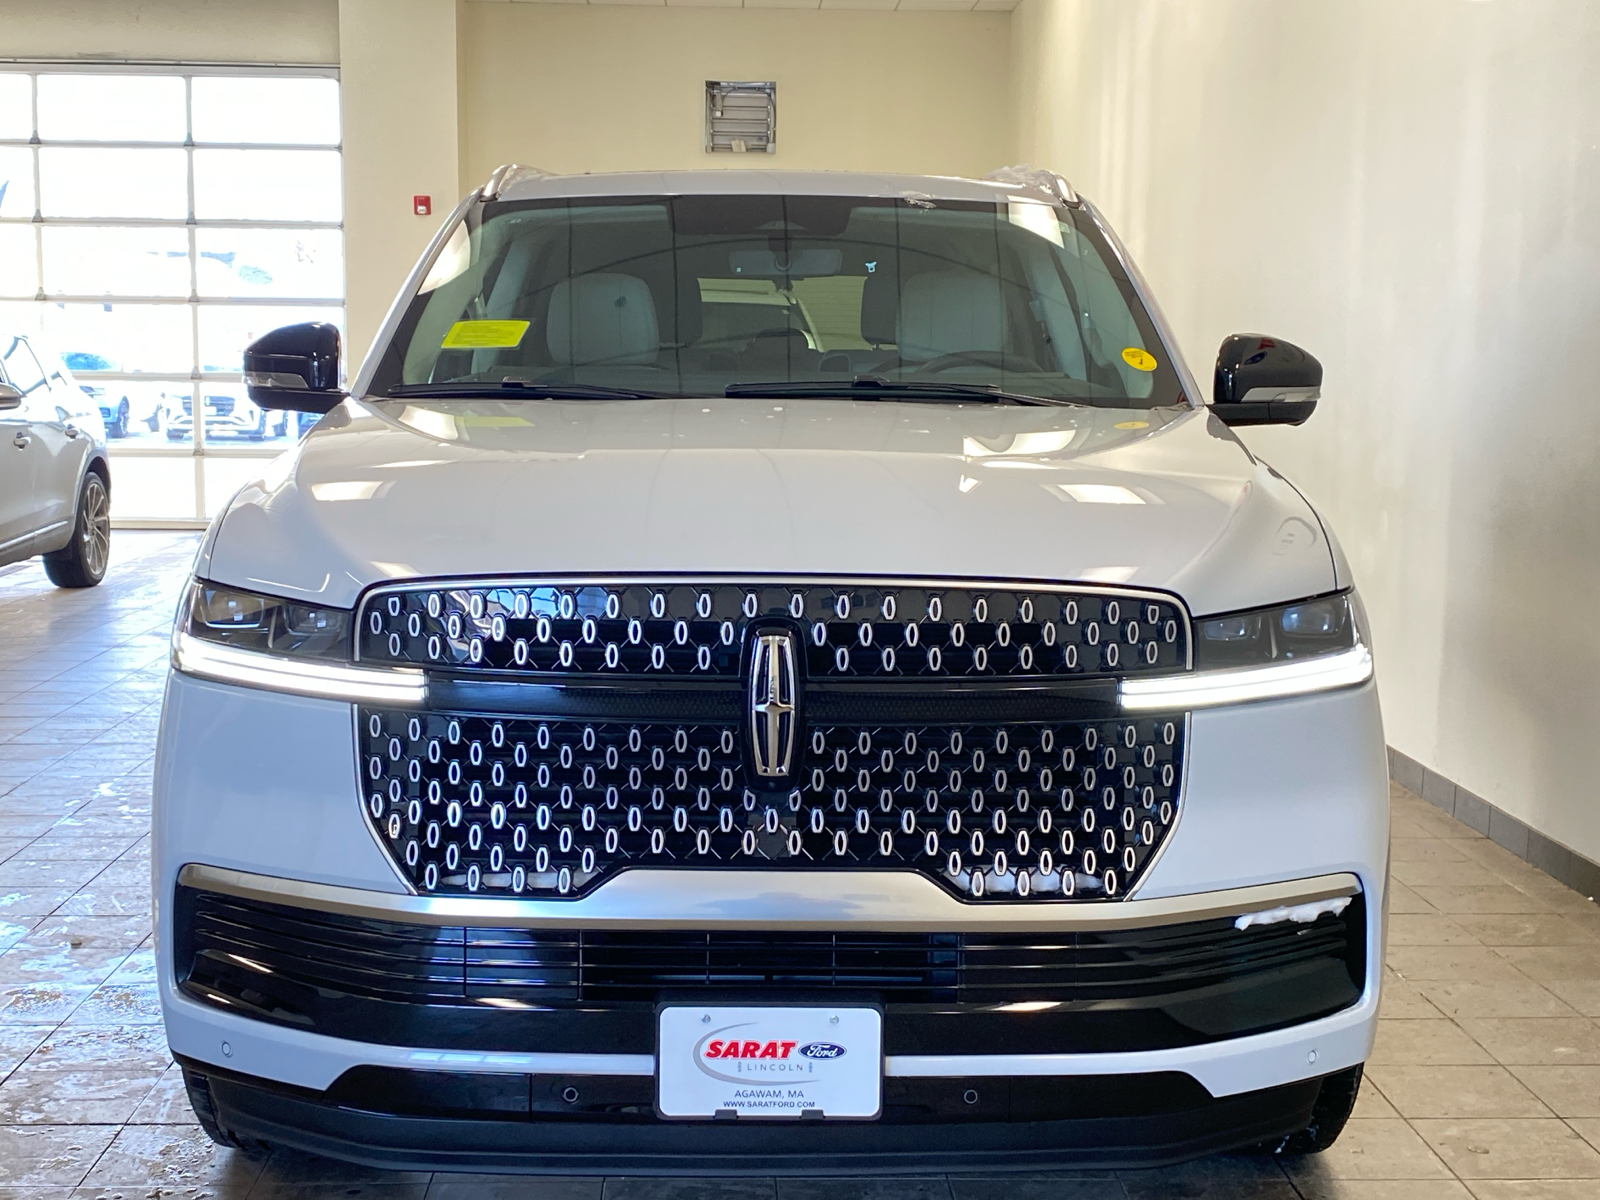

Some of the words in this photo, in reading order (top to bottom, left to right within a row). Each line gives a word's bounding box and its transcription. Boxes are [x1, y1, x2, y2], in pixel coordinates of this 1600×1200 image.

[705, 1040, 798, 1060] SARAT
[806, 1044, 839, 1057] Ford
[747, 1063, 804, 1072] LINCOLN
[734, 1089, 785, 1099] AGAWAM,
[788, 1089, 805, 1099] MA
[723, 1100, 816, 1108] WWW.SARATFORD.COM
